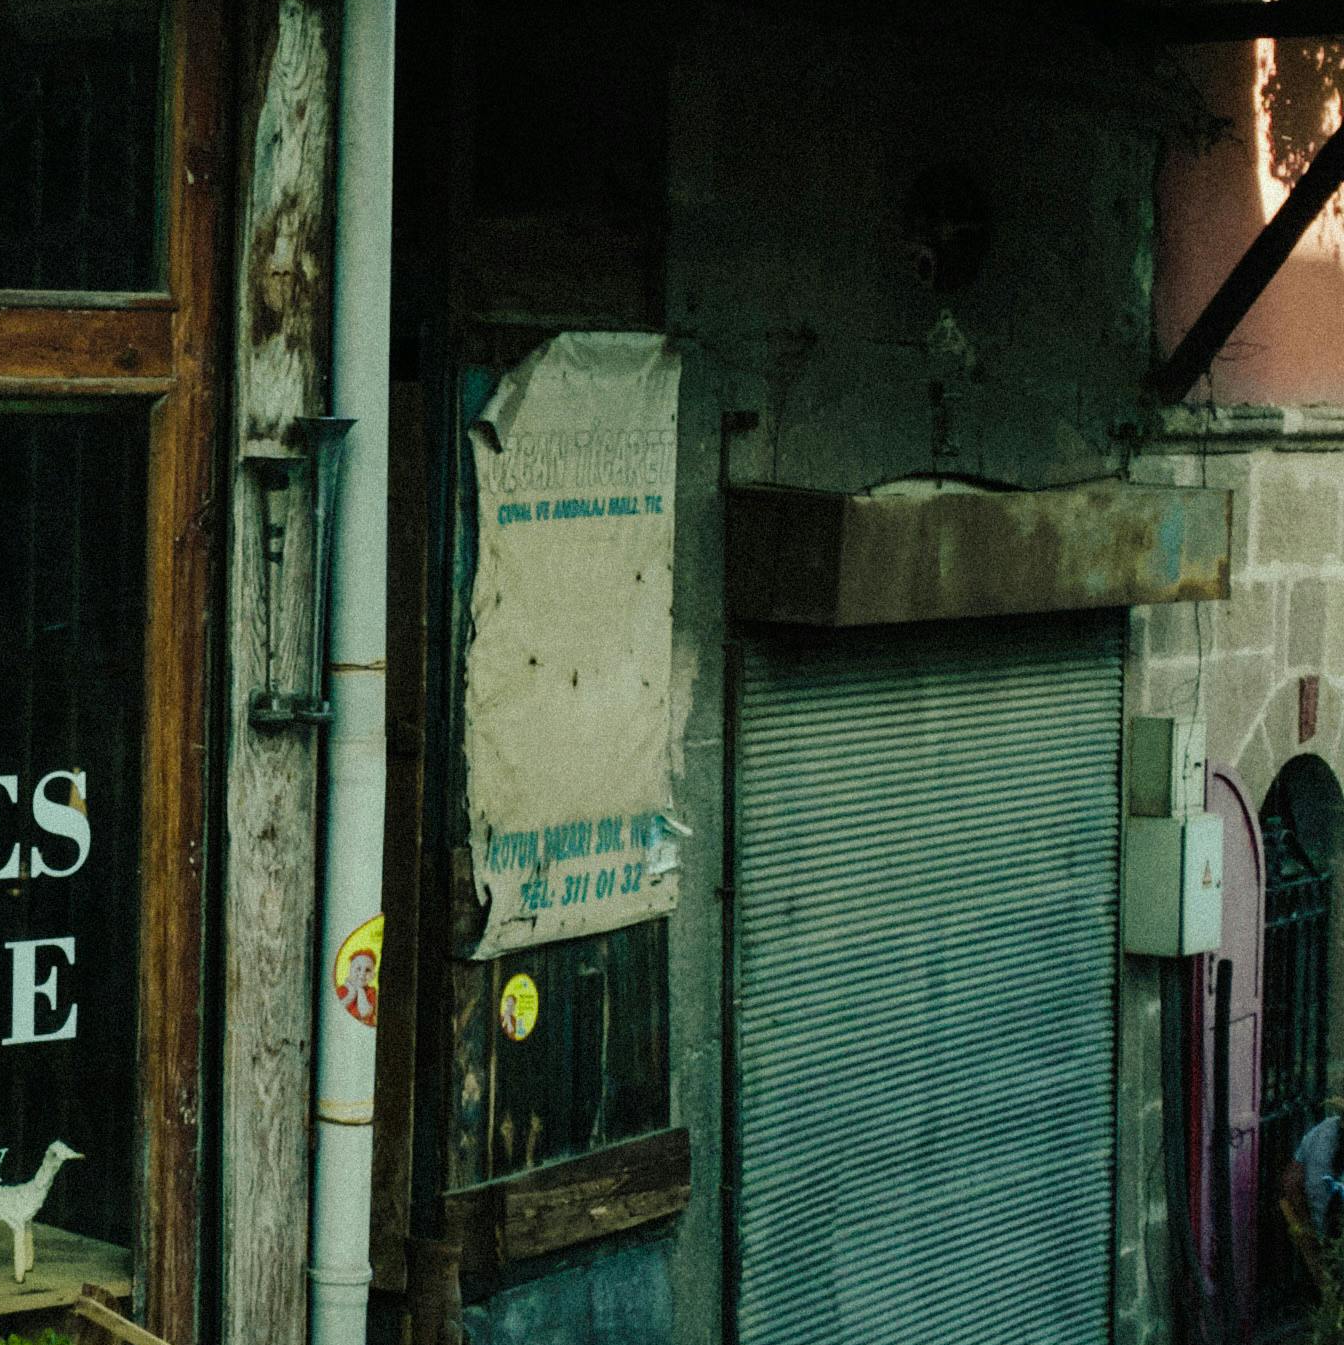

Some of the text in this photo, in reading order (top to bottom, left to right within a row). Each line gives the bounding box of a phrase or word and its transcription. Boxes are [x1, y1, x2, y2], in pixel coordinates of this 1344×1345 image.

[562, 871, 590, 906] 311
[596, 868, 616, 900] 01
[620, 862, 643, 895] 32
